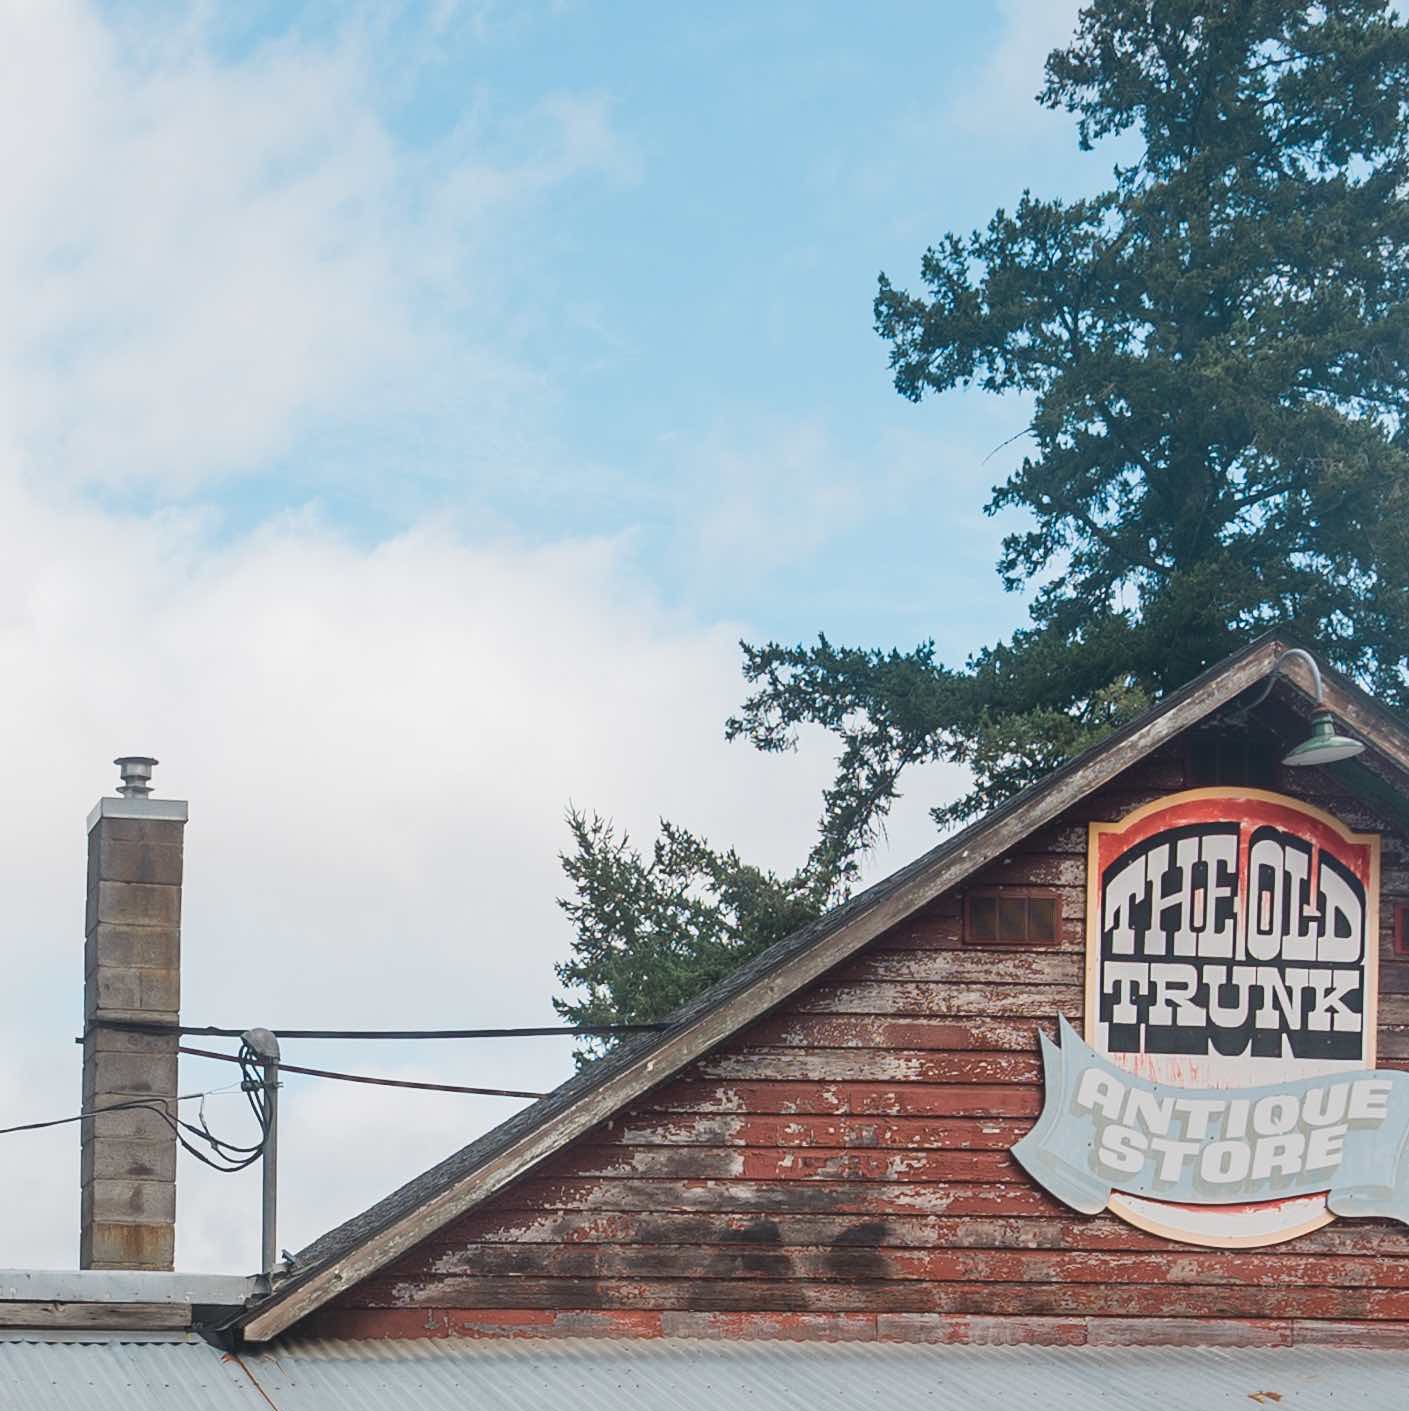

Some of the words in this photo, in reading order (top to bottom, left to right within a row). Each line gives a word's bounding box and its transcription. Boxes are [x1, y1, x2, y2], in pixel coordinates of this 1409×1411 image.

[1104, 834, 1240, 960] THE
[1247, 838, 1364, 964] OLD
[1103, 962, 1362, 1034] TRUNK
[1076, 1068, 1394, 1142] ANTIQUE
[1098, 1123, 1347, 1185] STORE
